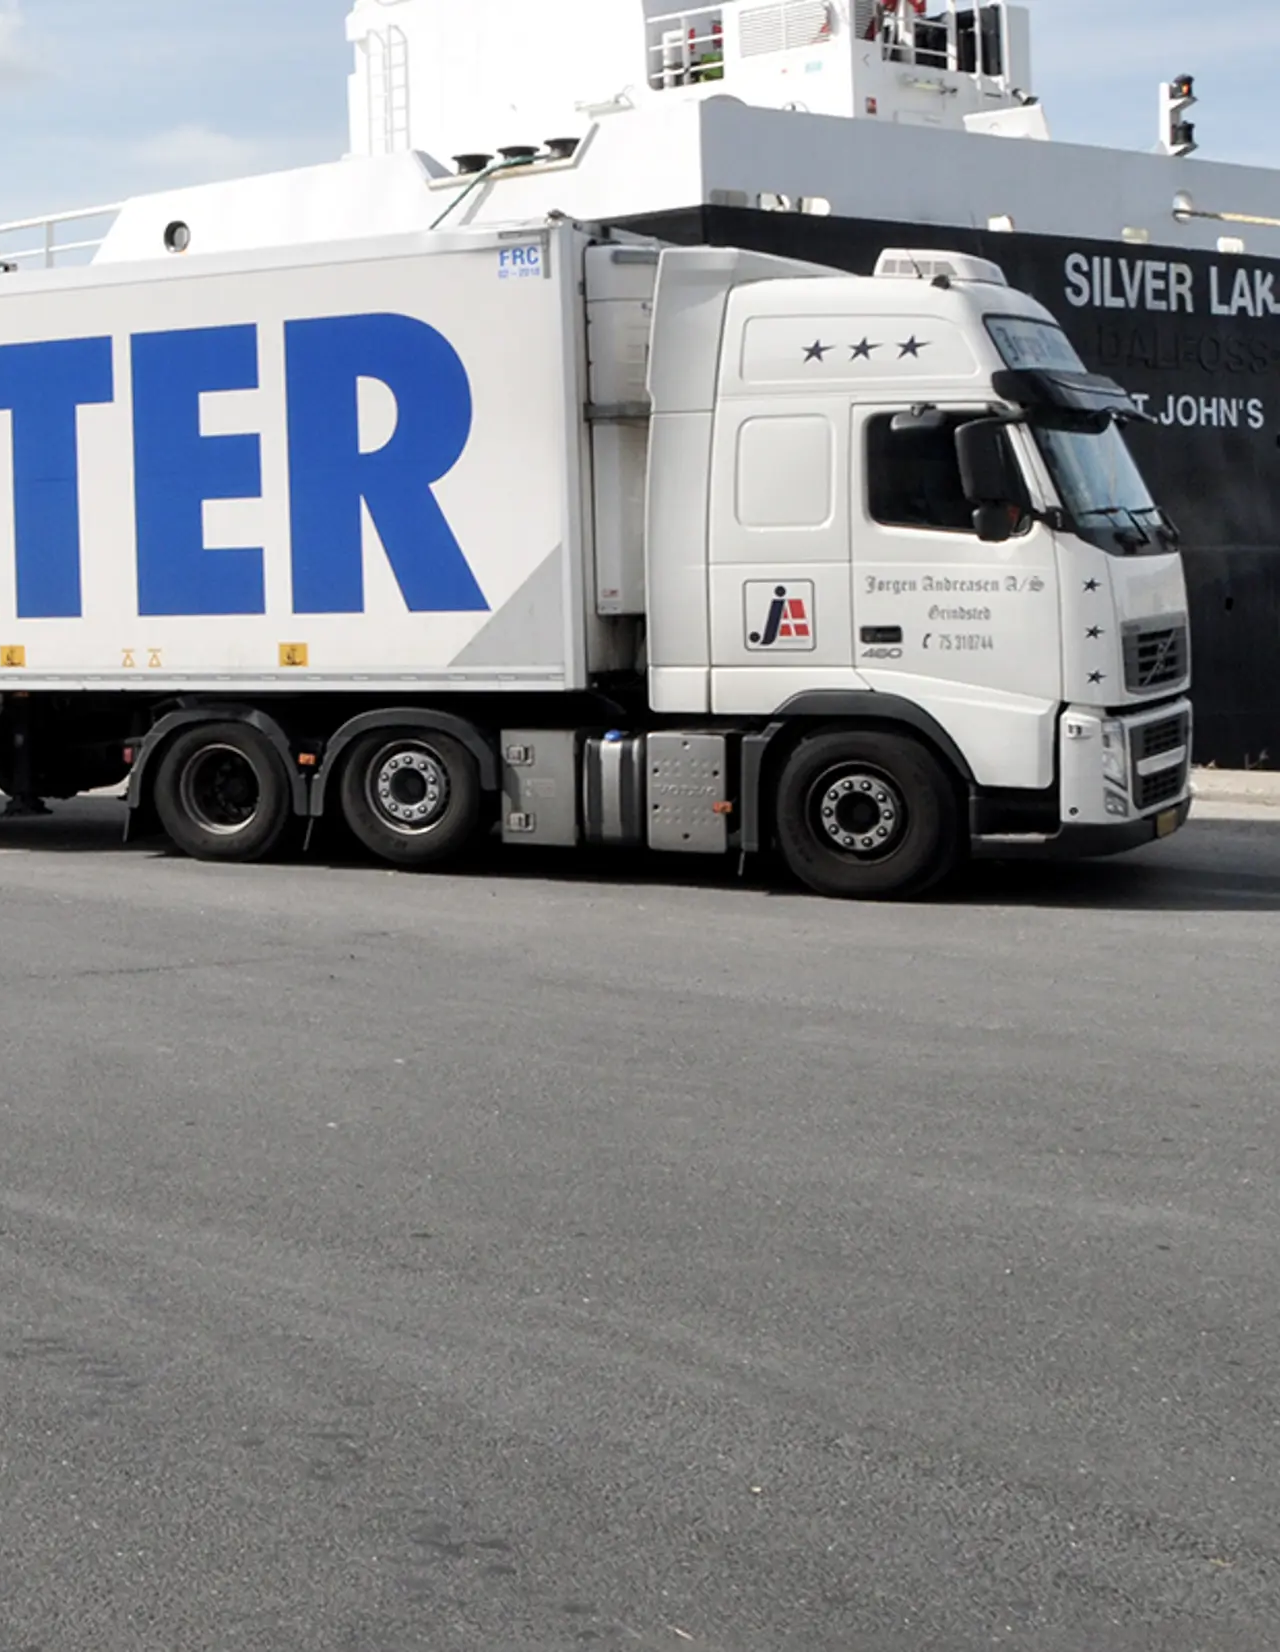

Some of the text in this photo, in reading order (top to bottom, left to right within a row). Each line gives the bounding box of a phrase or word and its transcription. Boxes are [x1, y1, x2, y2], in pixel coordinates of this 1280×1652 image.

[499, 247, 539, 267] FRC
[1064, 252, 1280, 318] SILVER LAK
[922, 574, 1000, 592] Andreasen
[1005, 574, 1046, 593] A/S
[928, 604, 992, 621] Grindsted
